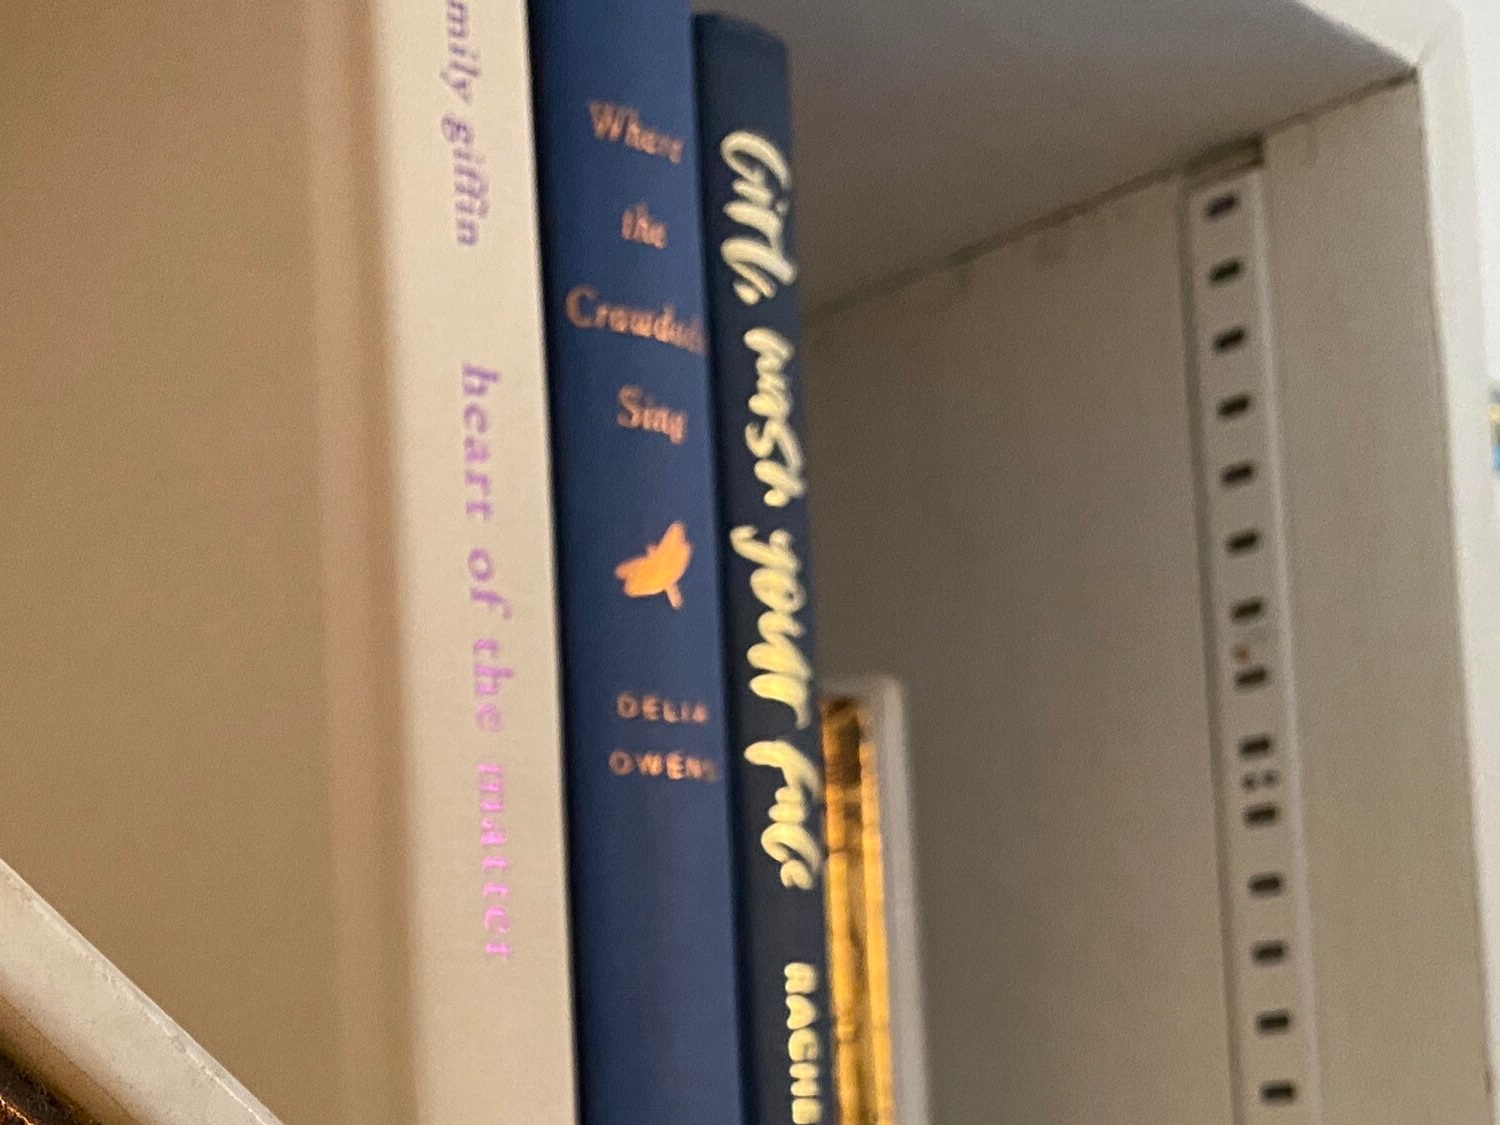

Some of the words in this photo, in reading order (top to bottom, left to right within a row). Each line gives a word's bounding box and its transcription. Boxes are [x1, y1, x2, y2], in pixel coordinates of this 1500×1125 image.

[440, 0, 481, 102] mily
[440, 112, 490, 247] giffin
[620, 203, 668, 250] the
[462, 362, 500, 521] heart
[617, 384, 688, 445] Sing
[468, 547, 512, 621] of
[729, 524, 811, 728] your
[473, 637, 514, 733] the
[616, 691, 709, 724] DELIA
[477, 762, 513, 961] matter
